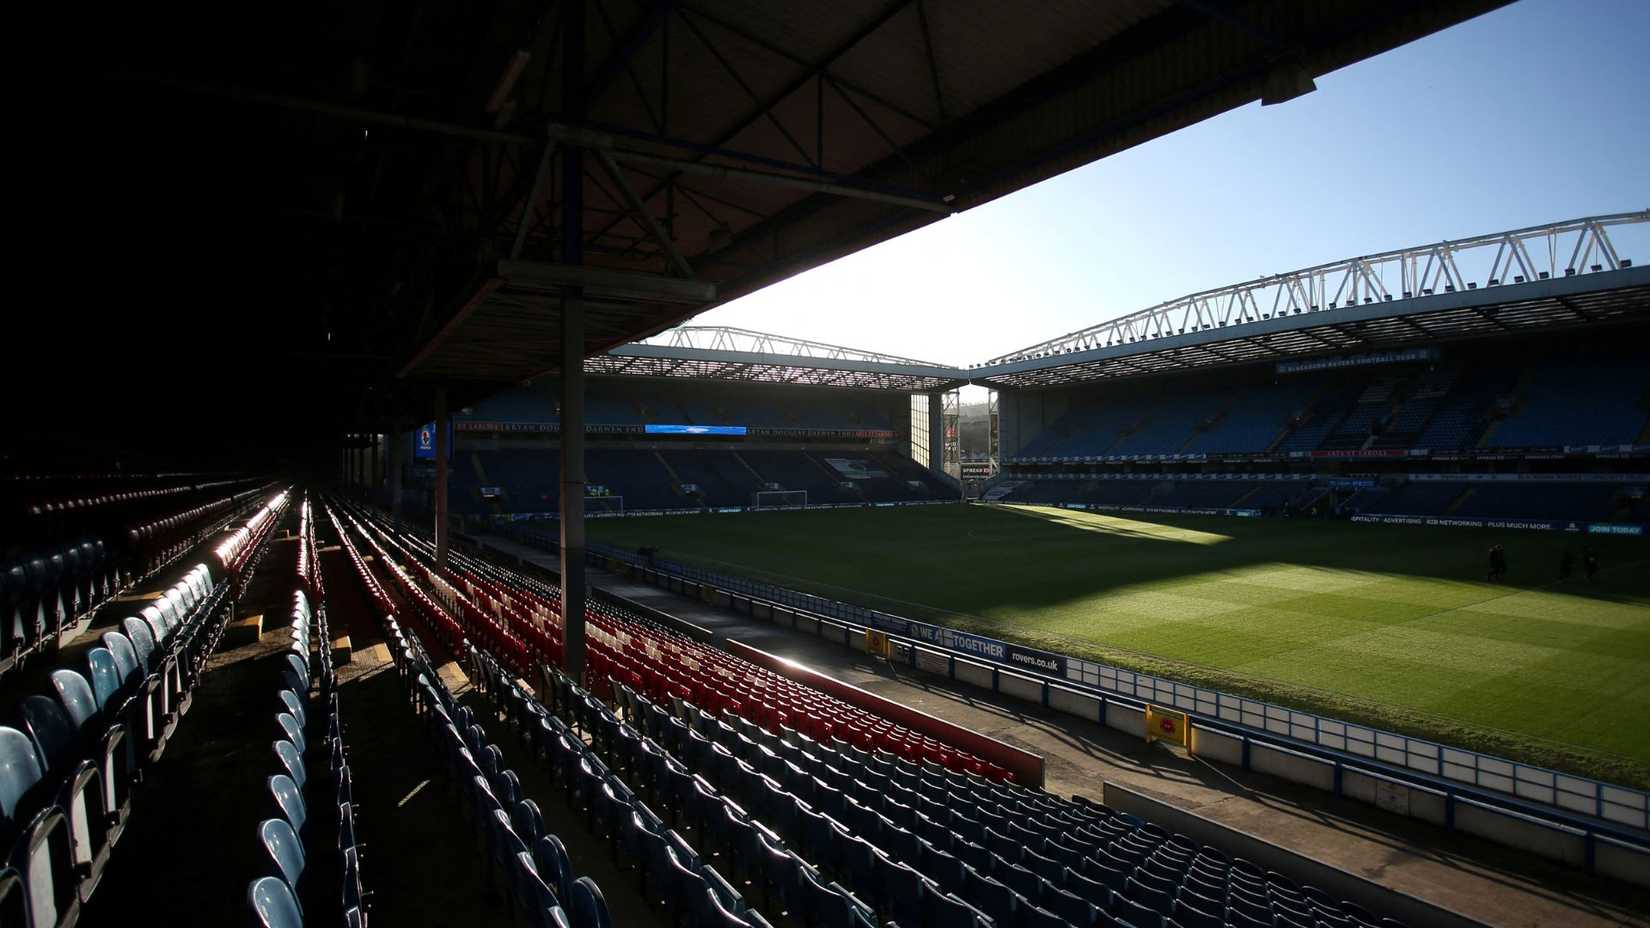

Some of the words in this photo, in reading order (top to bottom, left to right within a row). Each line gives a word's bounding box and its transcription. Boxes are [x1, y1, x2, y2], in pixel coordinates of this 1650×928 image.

[1383, 517, 1422, 525] ADVERTISING
[1439, 519, 1483, 527] NETWORKING
[1529, 522, 1551, 530] MORE
[1588, 526, 1610, 534] JOIN
[1612, 526, 1642, 535] TODAY
[920, 626, 934, 641] WE
[952, 636, 1004, 658] TOGETHER
[1012, 652, 1058, 672] rovers.co.uk
